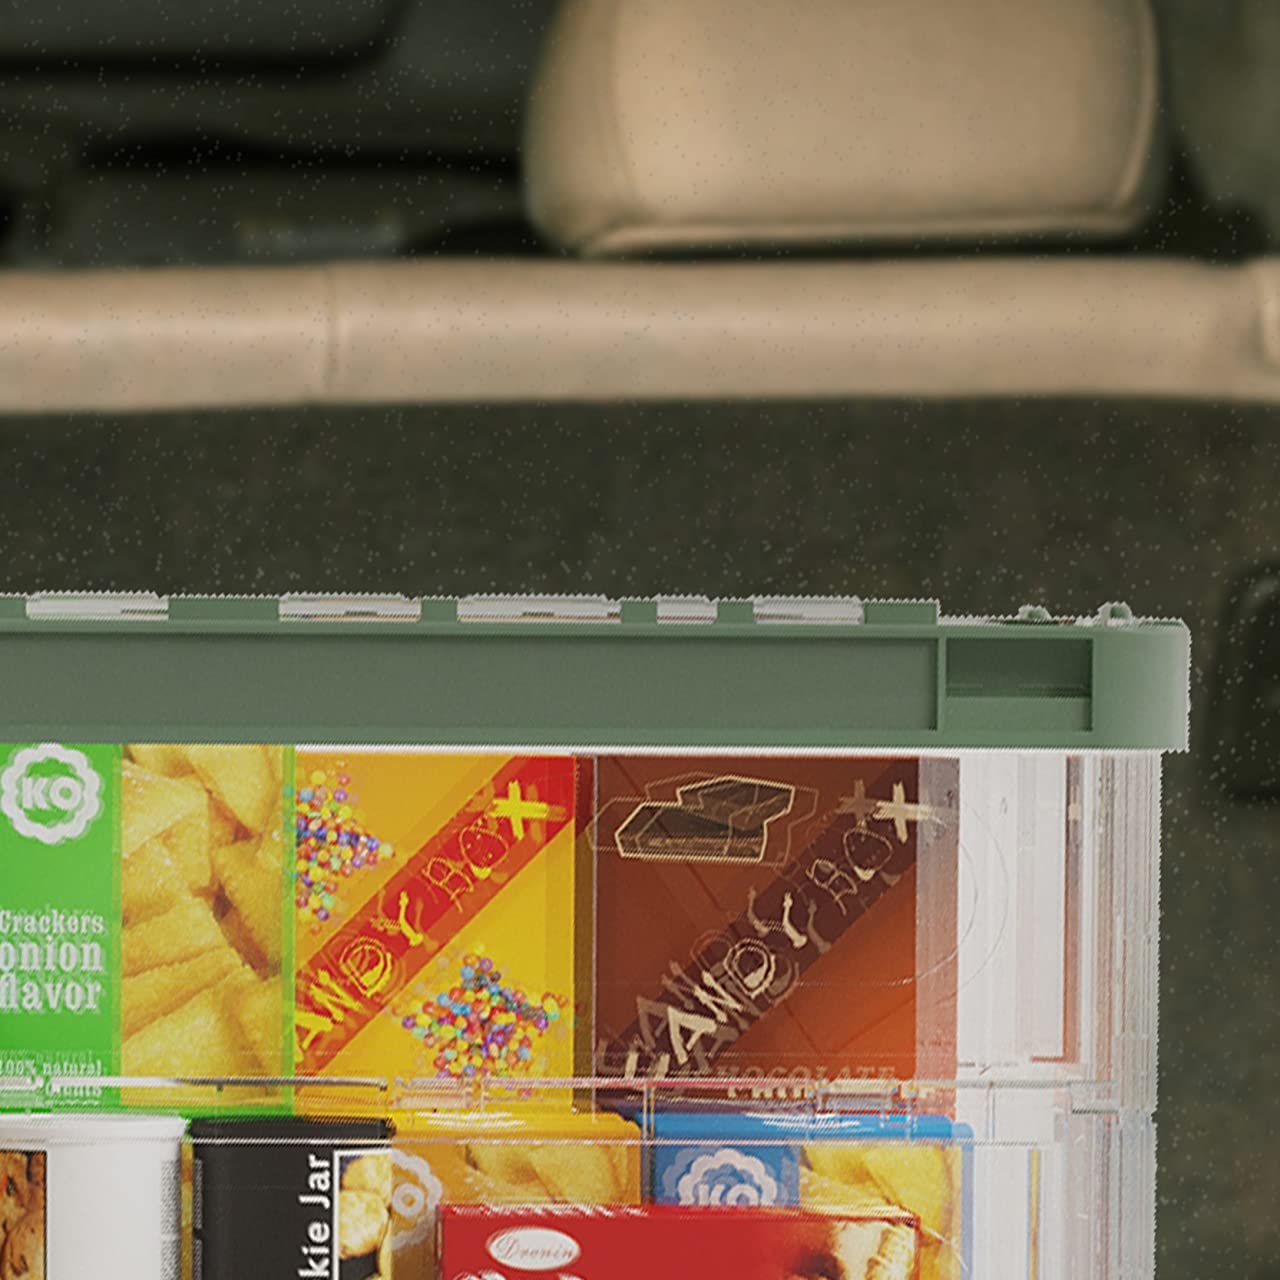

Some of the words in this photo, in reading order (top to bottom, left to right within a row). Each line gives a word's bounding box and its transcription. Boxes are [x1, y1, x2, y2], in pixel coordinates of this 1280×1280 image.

[22, 775, 83, 810] KO
[294, 891, 424, 1064] ANDY
[297, 1154, 331, 1209] Jar
